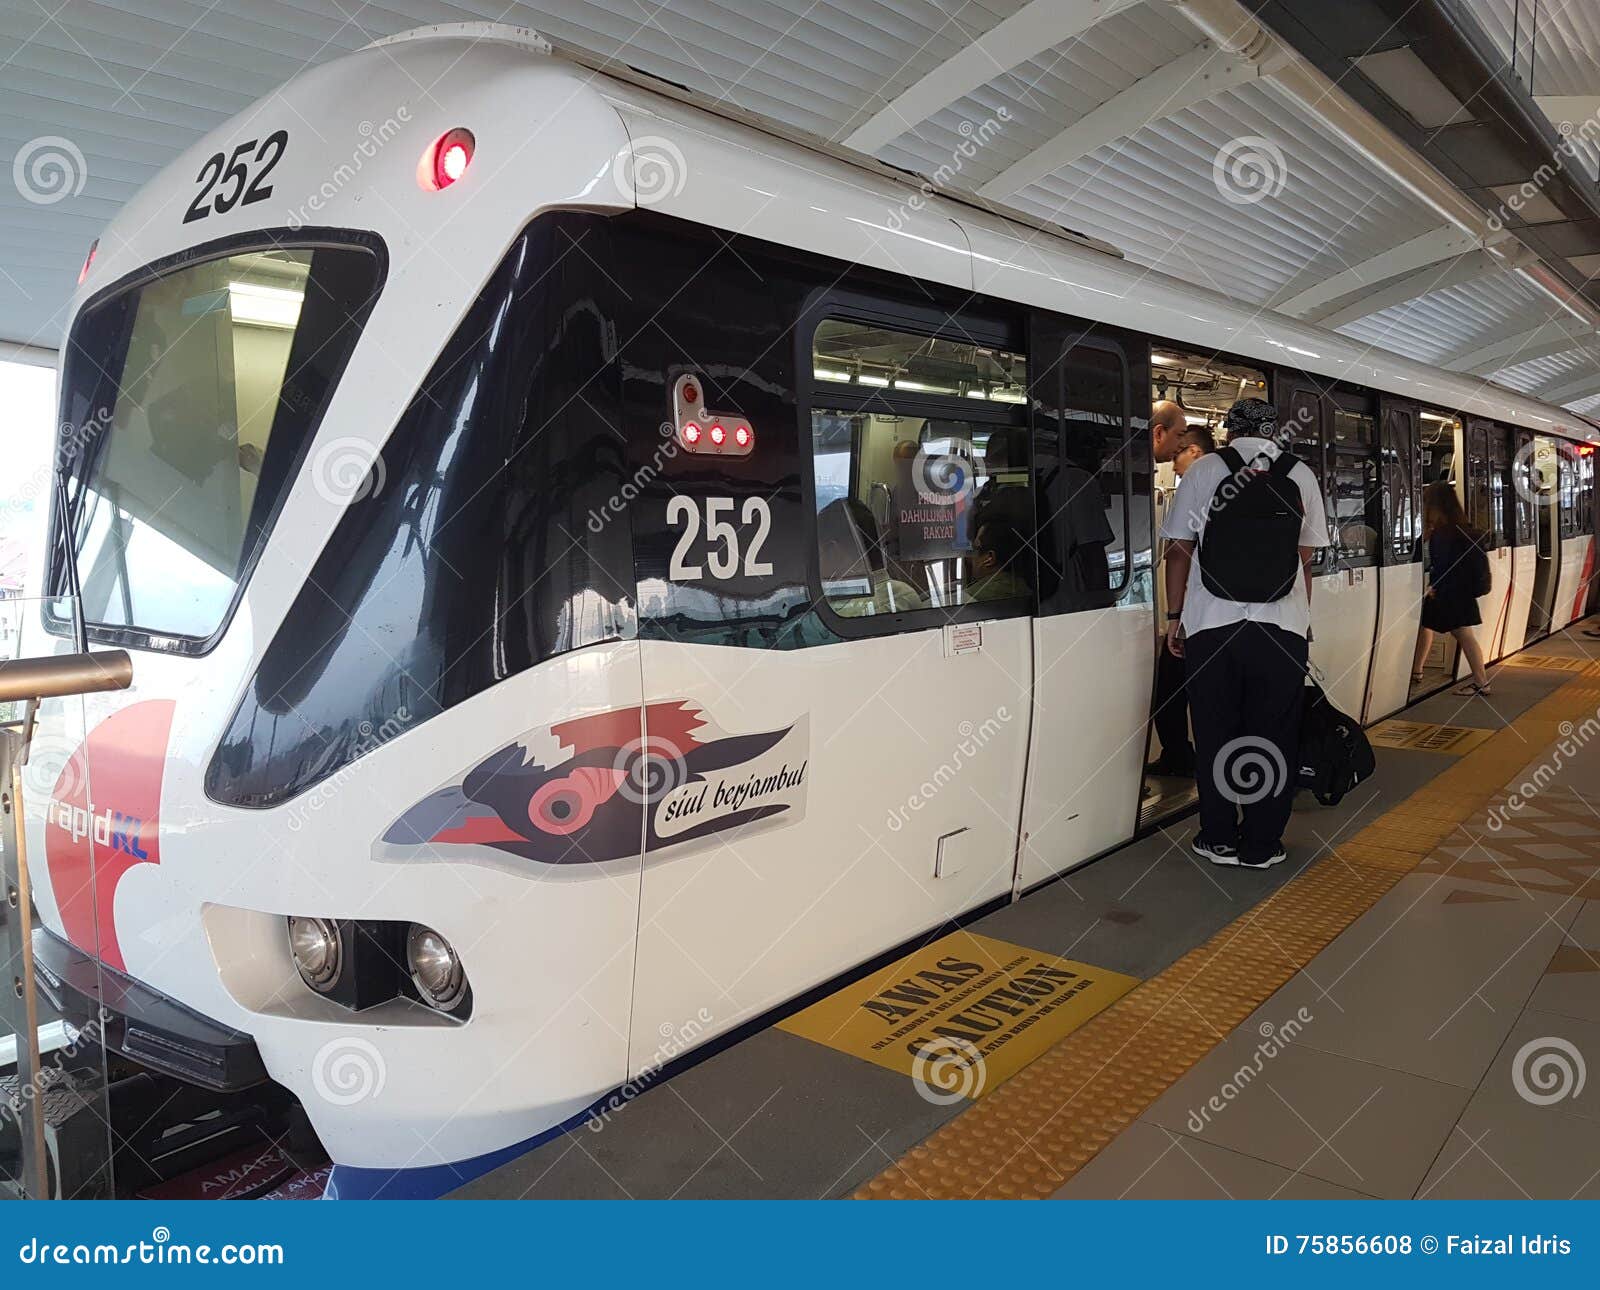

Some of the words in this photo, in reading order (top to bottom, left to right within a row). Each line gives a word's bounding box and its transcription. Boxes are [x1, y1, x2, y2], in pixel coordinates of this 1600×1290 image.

[183, 130, 288, 224] 252
[666, 495, 774, 581] 252
[900, 509, 953, 523] DAHULUKAN
[923, 526, 954, 540] RAKYAT
[664, 784, 708, 823] siul
[713, 759, 808, 811] berjambul
[860, 956, 984, 1025] AWAS
[906, 962, 1079, 1062] CAUTION
[871, 1036, 896, 1050] SILA
